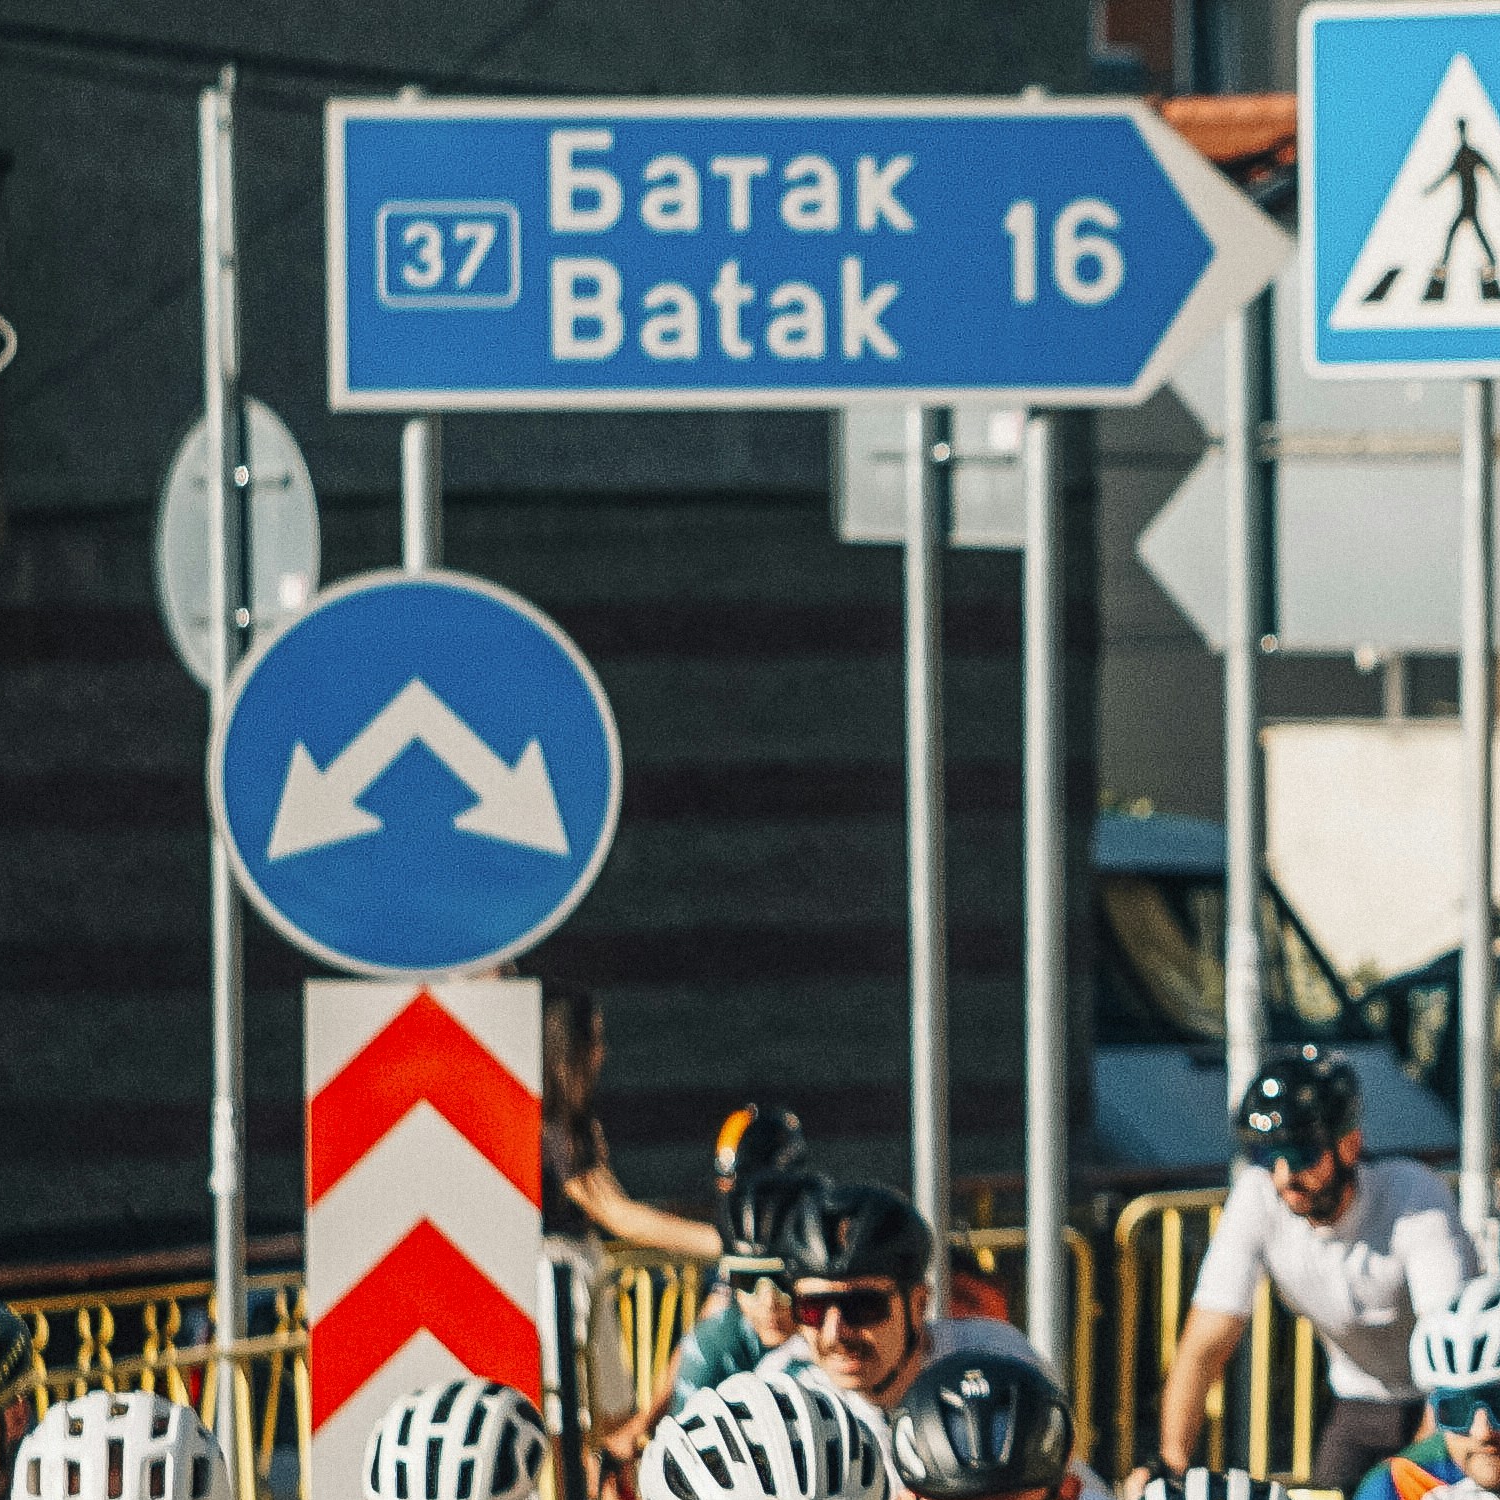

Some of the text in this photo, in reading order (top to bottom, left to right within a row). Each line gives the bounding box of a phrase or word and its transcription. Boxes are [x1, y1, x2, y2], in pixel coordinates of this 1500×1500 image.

[549, 129, 916, 233] Батак
[401, 221, 497, 288] 37
[1003, 199, 1124, 305] 16
[549, 256, 900, 361] Batak
